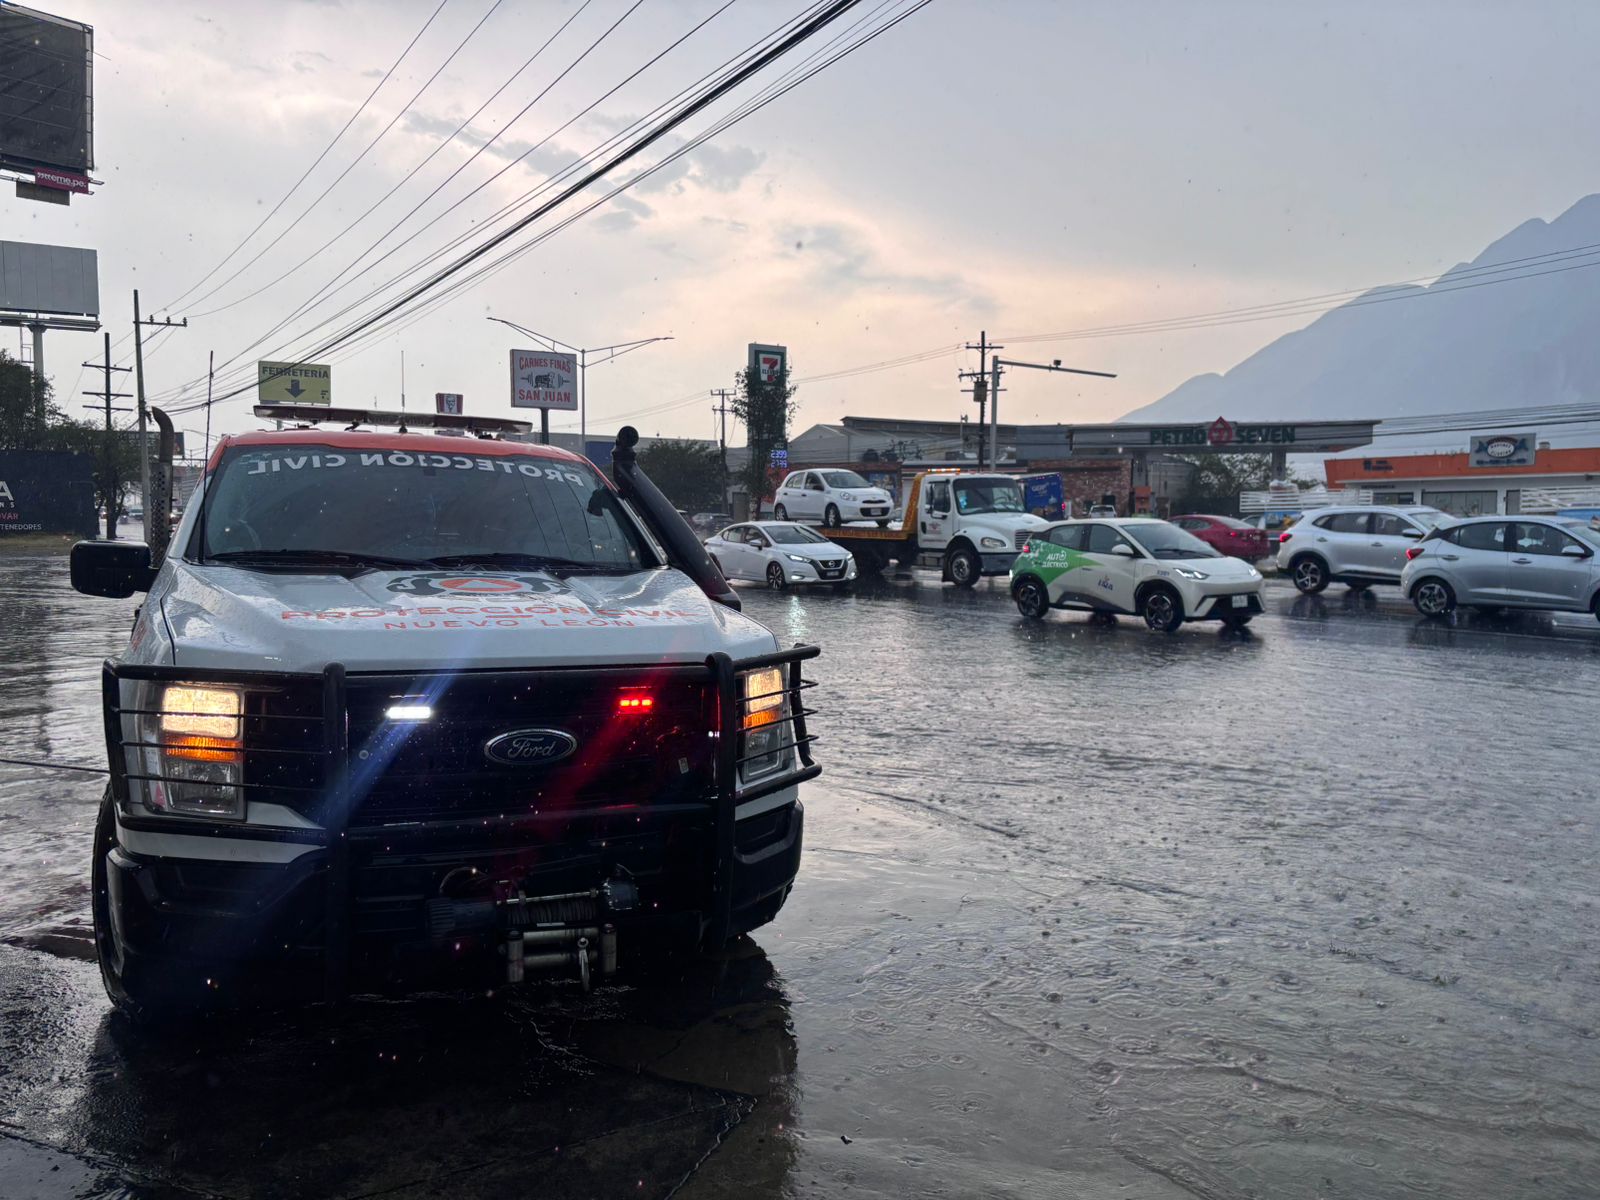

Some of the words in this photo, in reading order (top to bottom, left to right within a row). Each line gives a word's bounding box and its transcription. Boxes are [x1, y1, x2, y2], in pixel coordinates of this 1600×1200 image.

[262, 366, 329, 379] FERRETERÍA
[519, 356, 548, 370] CARNES
[549, 359, 571, 374] FINAS
[762, 356, 779, 383] 7
[518, 388, 540, 401] SAN
[543, 390, 571, 403] JUAN
[1150, 428, 1207, 445] PETRO
[1235, 426, 1296, 444] SEVEN
[281, 604, 591, 620] PROTECCIÓN
[596, 605, 700, 618] CIVIL
[384, 619, 520, 630] NUEVO
[540, 617, 636, 628] LEÓN
[507, 736, 557, 758] Ford
